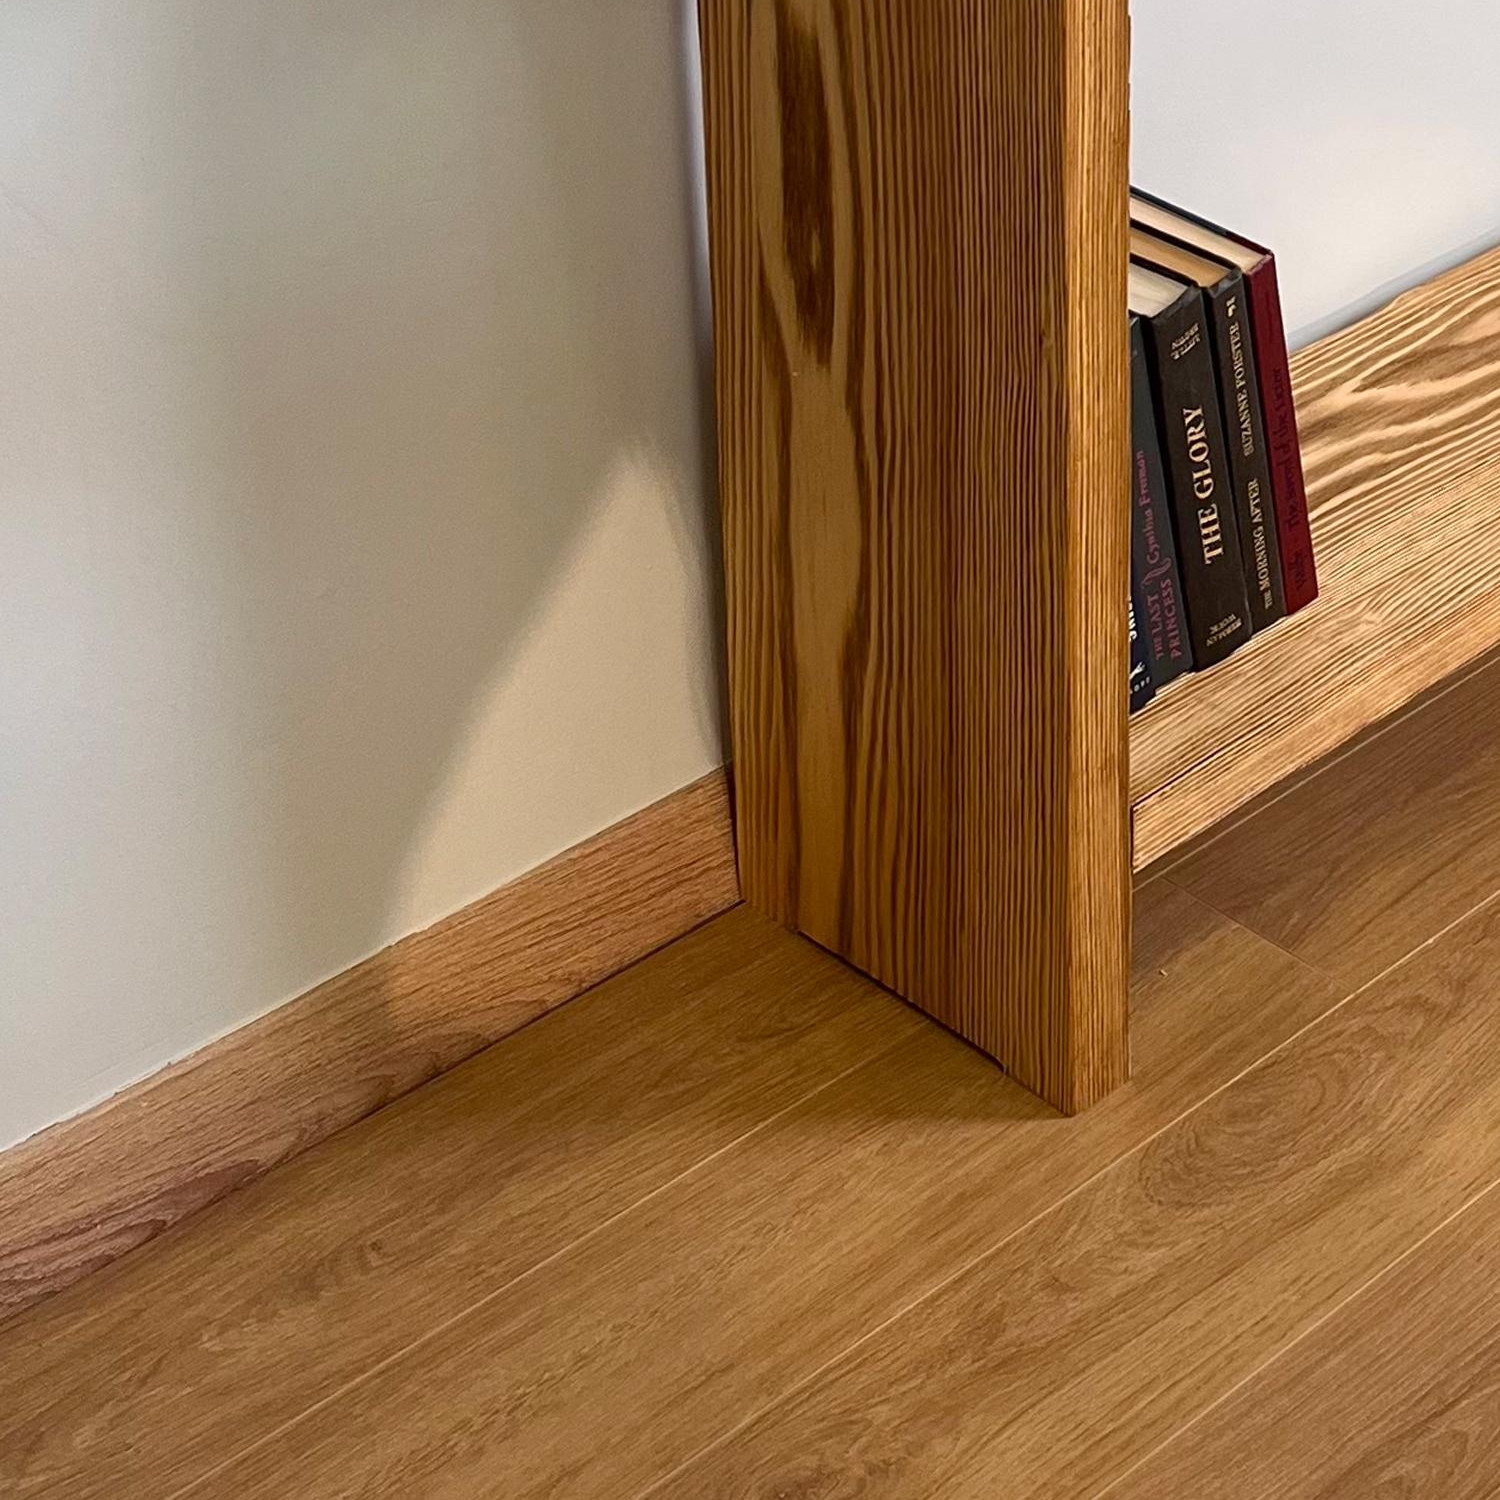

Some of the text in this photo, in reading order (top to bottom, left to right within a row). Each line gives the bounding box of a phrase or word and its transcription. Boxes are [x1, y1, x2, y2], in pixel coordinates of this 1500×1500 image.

[1229, 322, 1254, 457] SUZANNE FORSTER
[1136, 450, 1160, 564] Cynthia Freeman
[1183, 405, 1224, 565] THE GLORY
[1248, 478, 1274, 610] THE MORNING AFTER
[1147, 594, 1164, 660] THE LAST
[1161, 579, 1182, 660] PRINCESS
